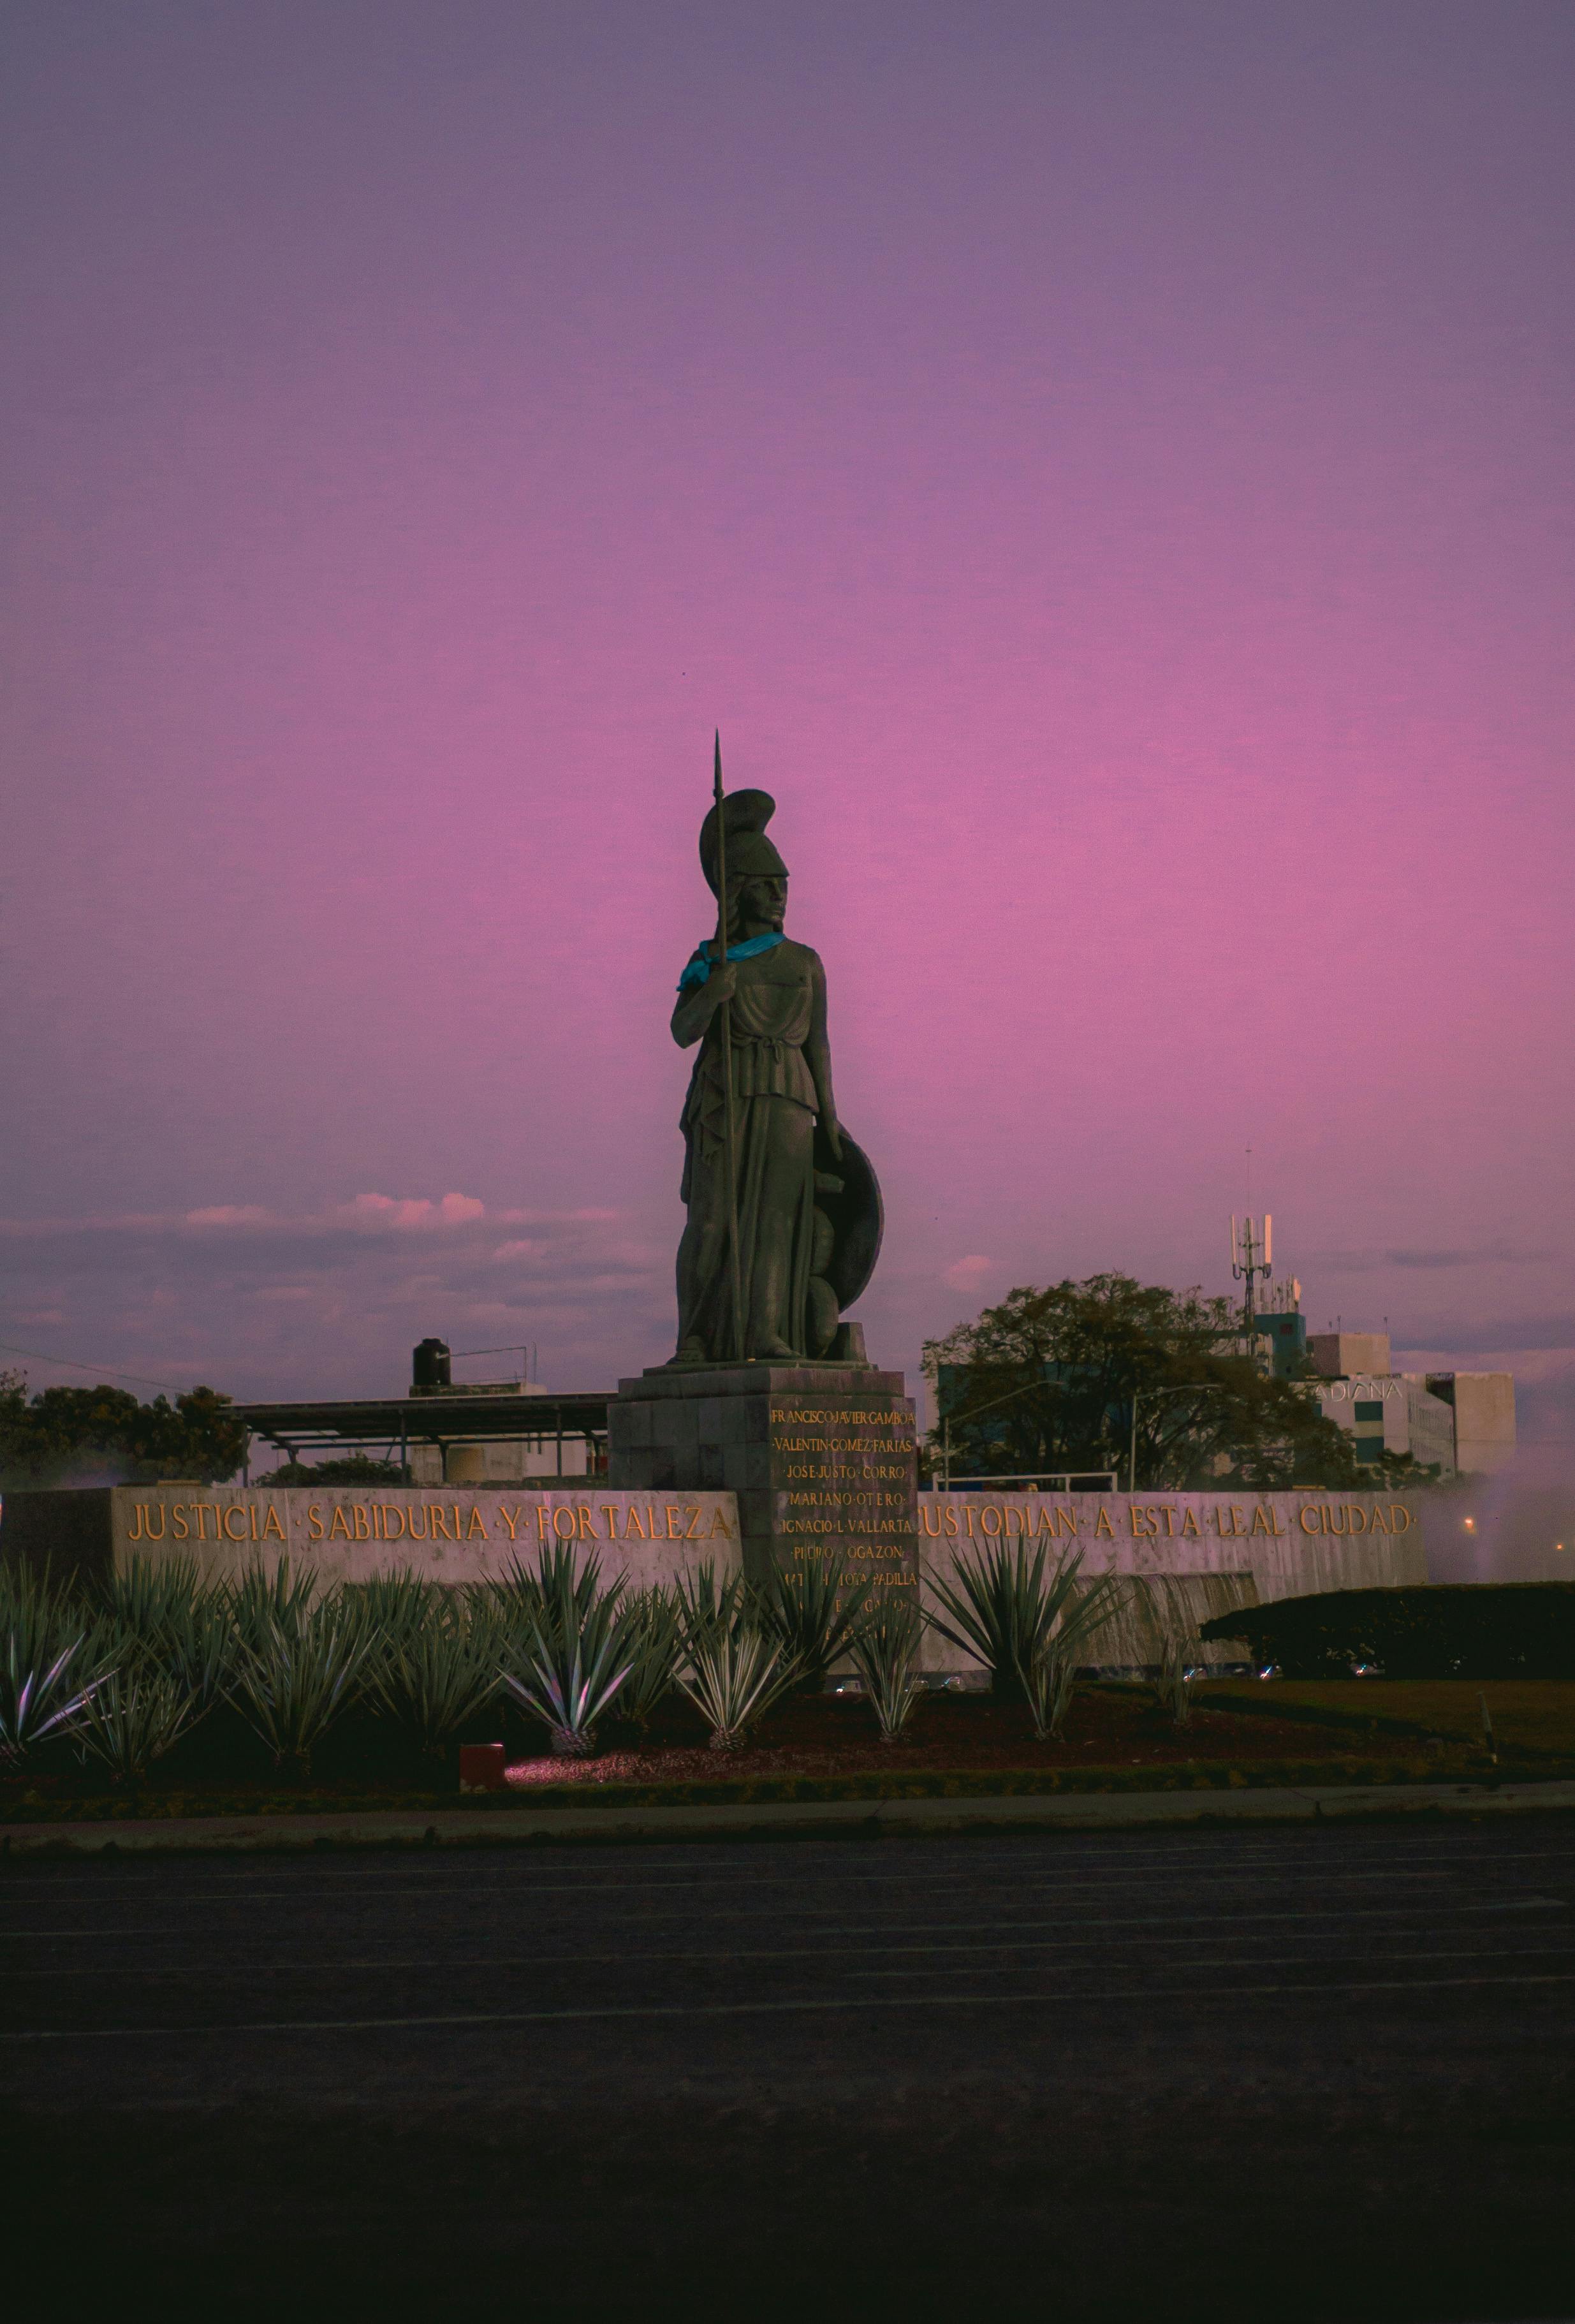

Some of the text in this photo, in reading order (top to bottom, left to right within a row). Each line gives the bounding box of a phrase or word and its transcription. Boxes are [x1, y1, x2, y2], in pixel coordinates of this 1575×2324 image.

[772, 1409, 915, 1425] FRANCISCO JAVIER GAMBOA
[774, 1438, 912, 1452] VALENTIN GOMEZ FARIAS
[787, 1466, 905, 1480] JOSE JUSTO CORRO
[790, 1492, 903, 1506] MARIANO OTERO
[128, 1504, 732, 1541] JUSTICIA SABIDURIA Y FORTALEZA
[782, 1520, 832, 1533] IGNACIO
[848, 1520, 912, 1533] VALLARTA
[1095, 1506, 1115, 1537] A
[1129, 1506, 1202, 1537] ESTA
[1215, 1505, 1286, 1536] LEAL
[1300, 1504, 1410, 1535] CIUDAD
[847, 1546, 903, 1559] OGAZON
[874, 1572, 917, 1585] PADILLA
